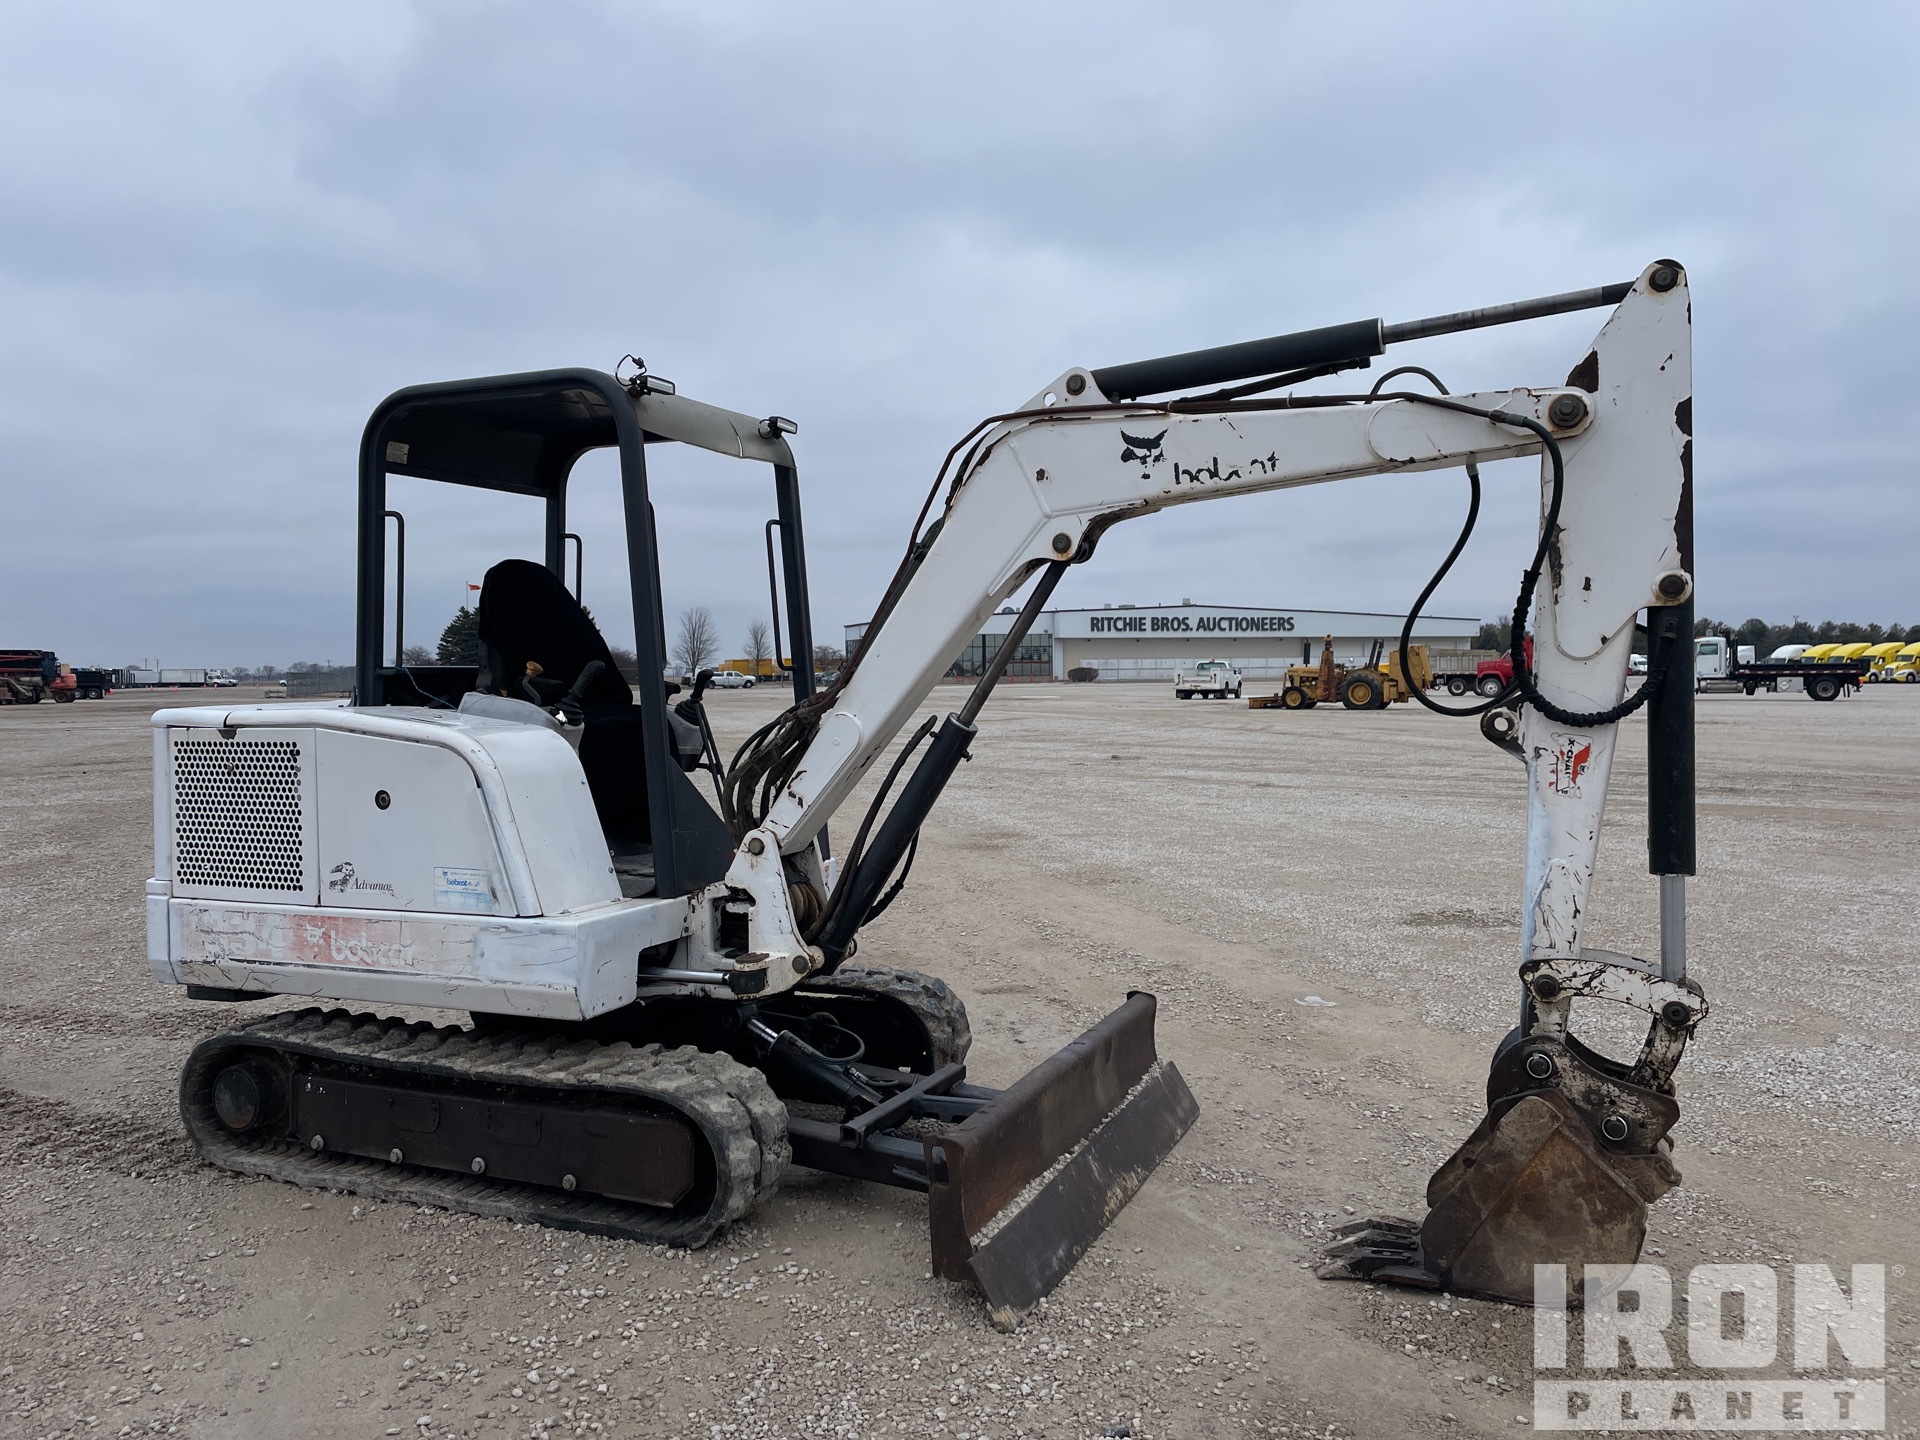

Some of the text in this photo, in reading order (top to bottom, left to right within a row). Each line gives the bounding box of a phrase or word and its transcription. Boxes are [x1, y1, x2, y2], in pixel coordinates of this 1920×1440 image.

[1090, 616, 1295, 632] RITCHIE BROS. AUCTIONEERS
[446, 877, 468, 887] bobcat
